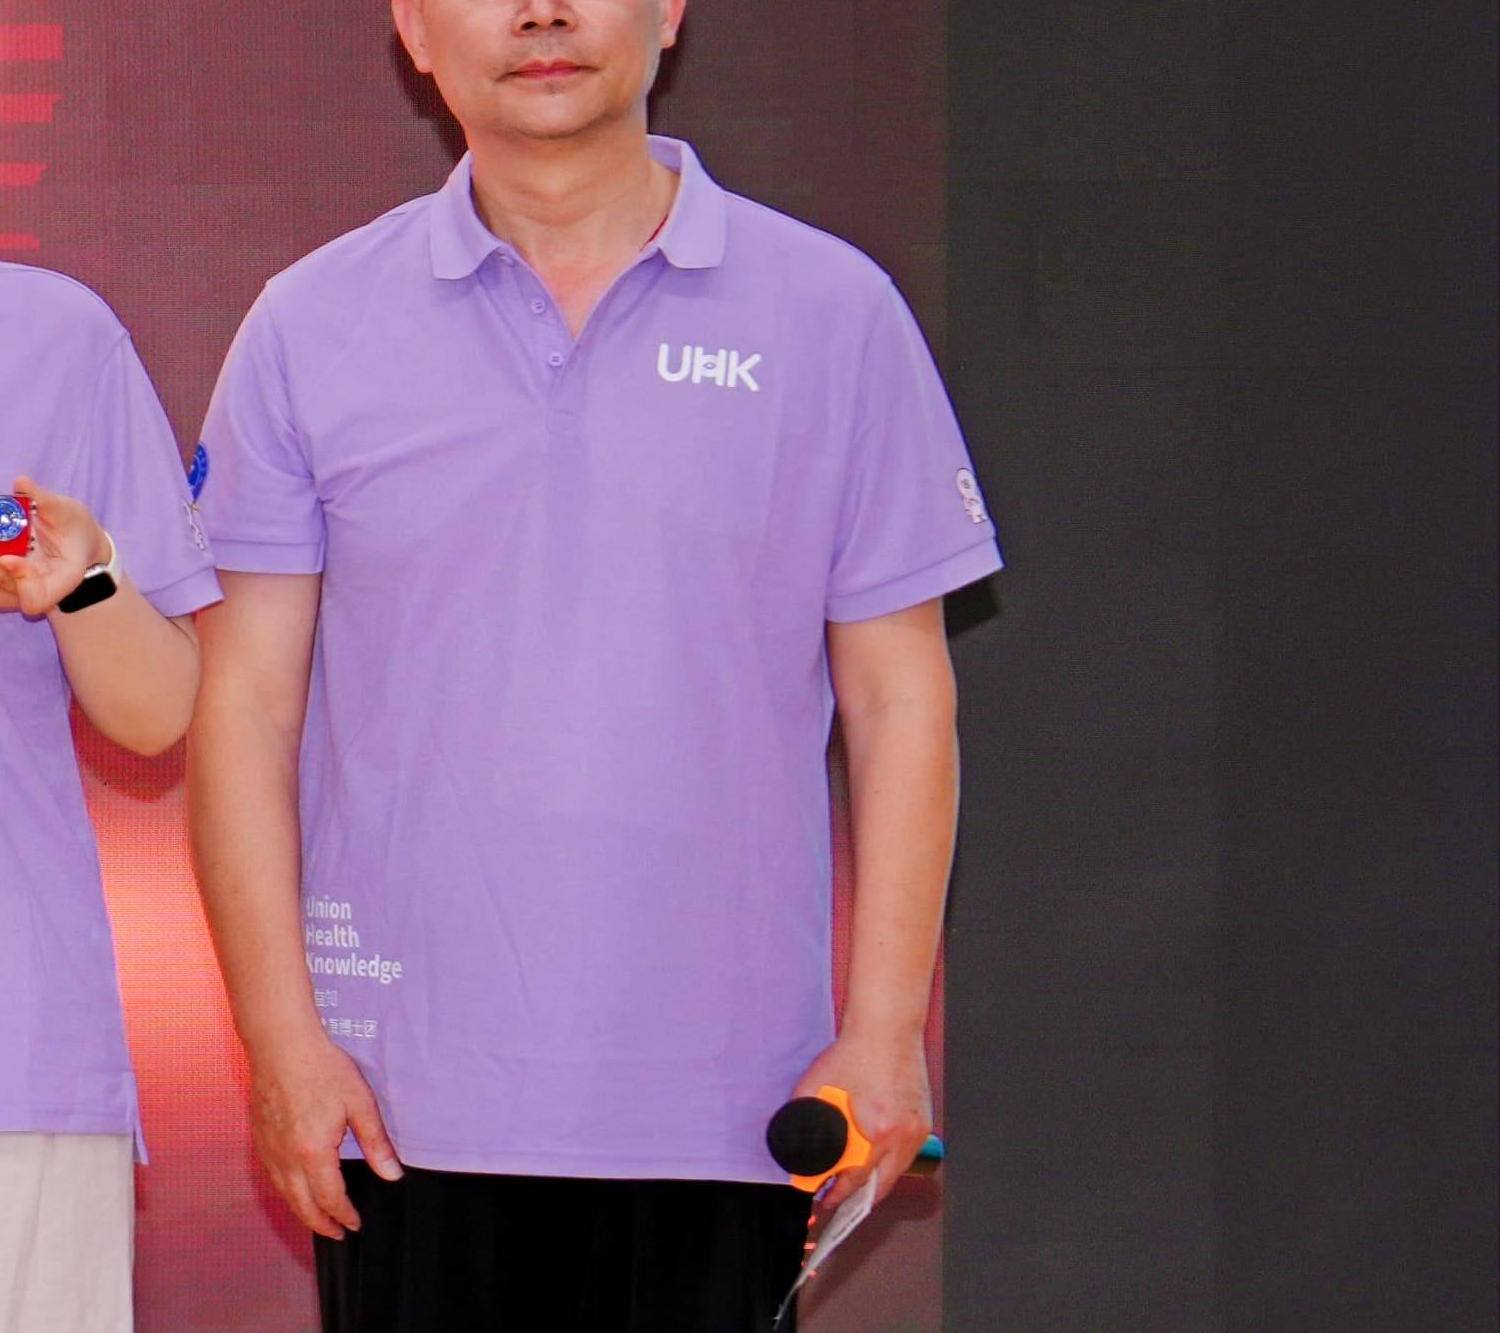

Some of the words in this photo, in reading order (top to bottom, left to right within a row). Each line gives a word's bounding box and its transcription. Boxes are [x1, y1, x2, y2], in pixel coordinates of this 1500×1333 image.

[657, 343, 761, 391] UHK
[307, 895, 352, 919] Union
[305, 924, 360, 947] Health
[305, 951, 403, 984] Knowledge
